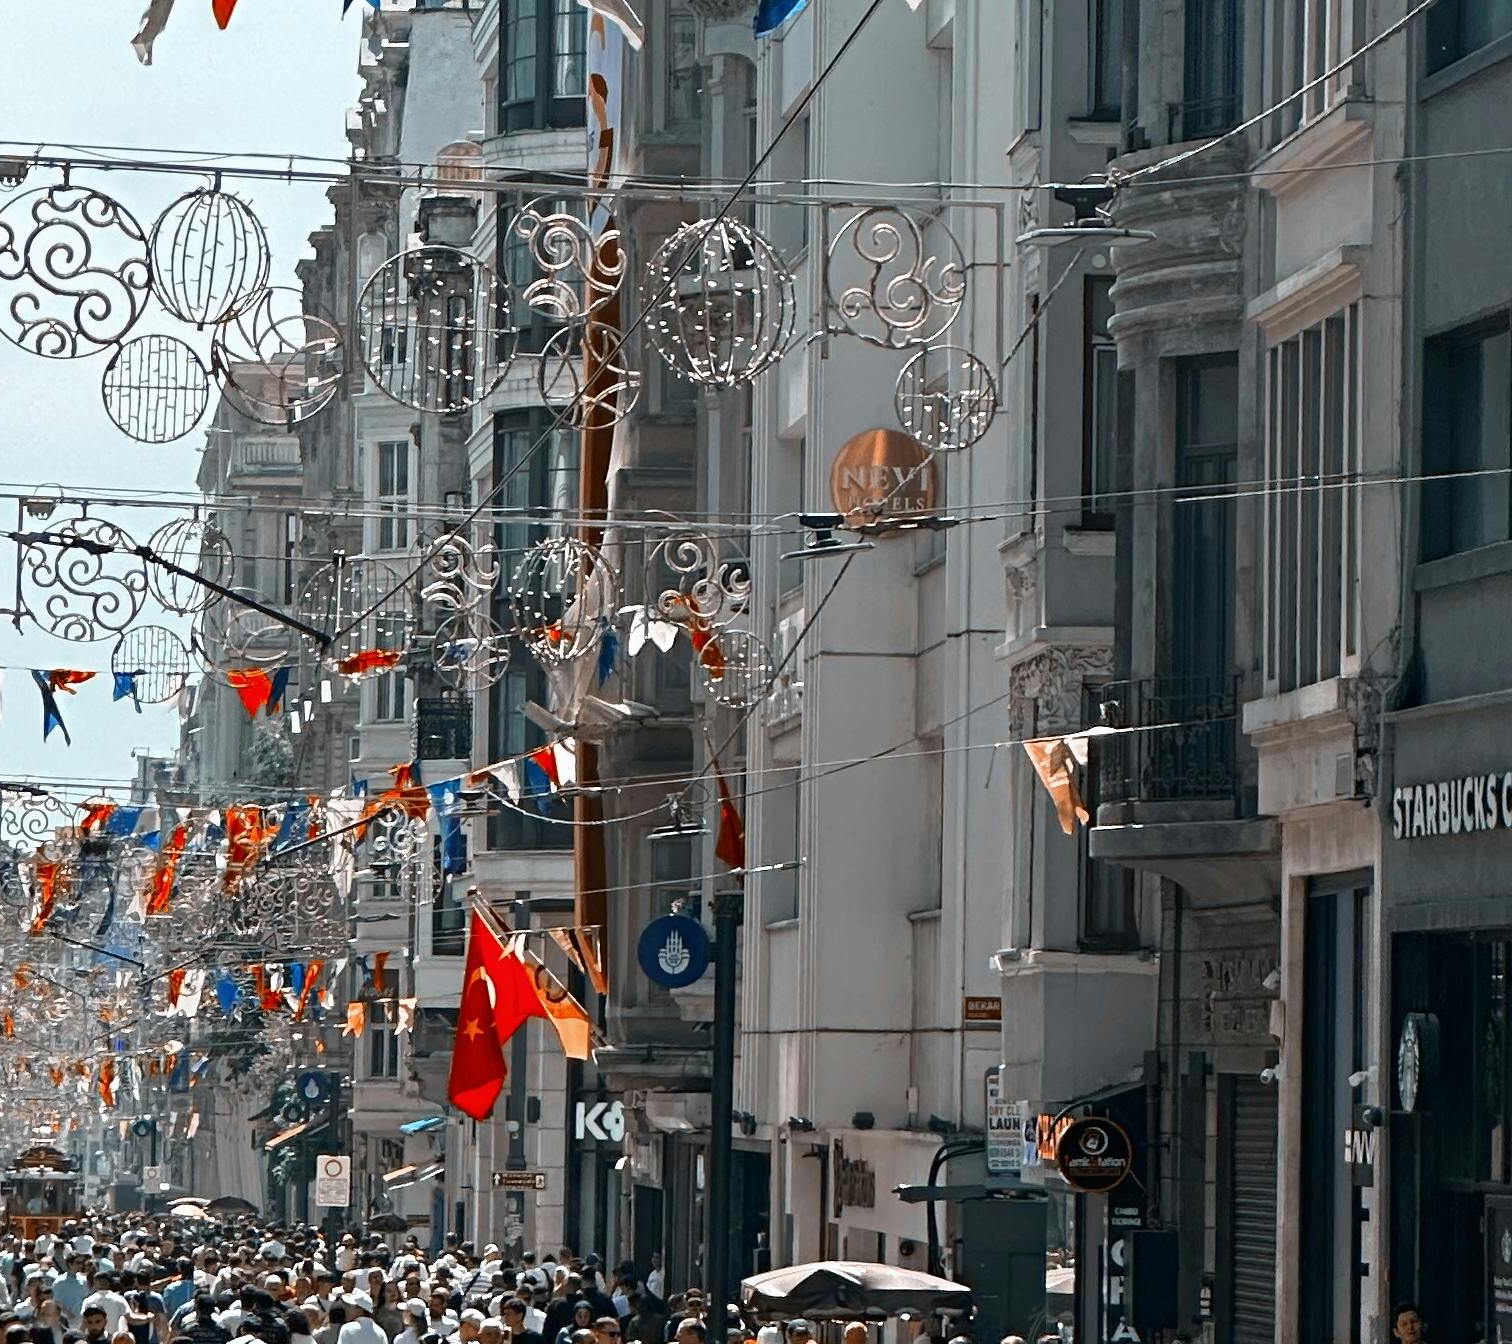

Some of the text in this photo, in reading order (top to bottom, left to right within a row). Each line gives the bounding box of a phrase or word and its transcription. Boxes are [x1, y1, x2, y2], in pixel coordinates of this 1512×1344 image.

[841, 464, 928, 491] NEVI
[848, 495, 925, 512] HOELS
[1393, 774, 1497, 840] STARBUCKS
